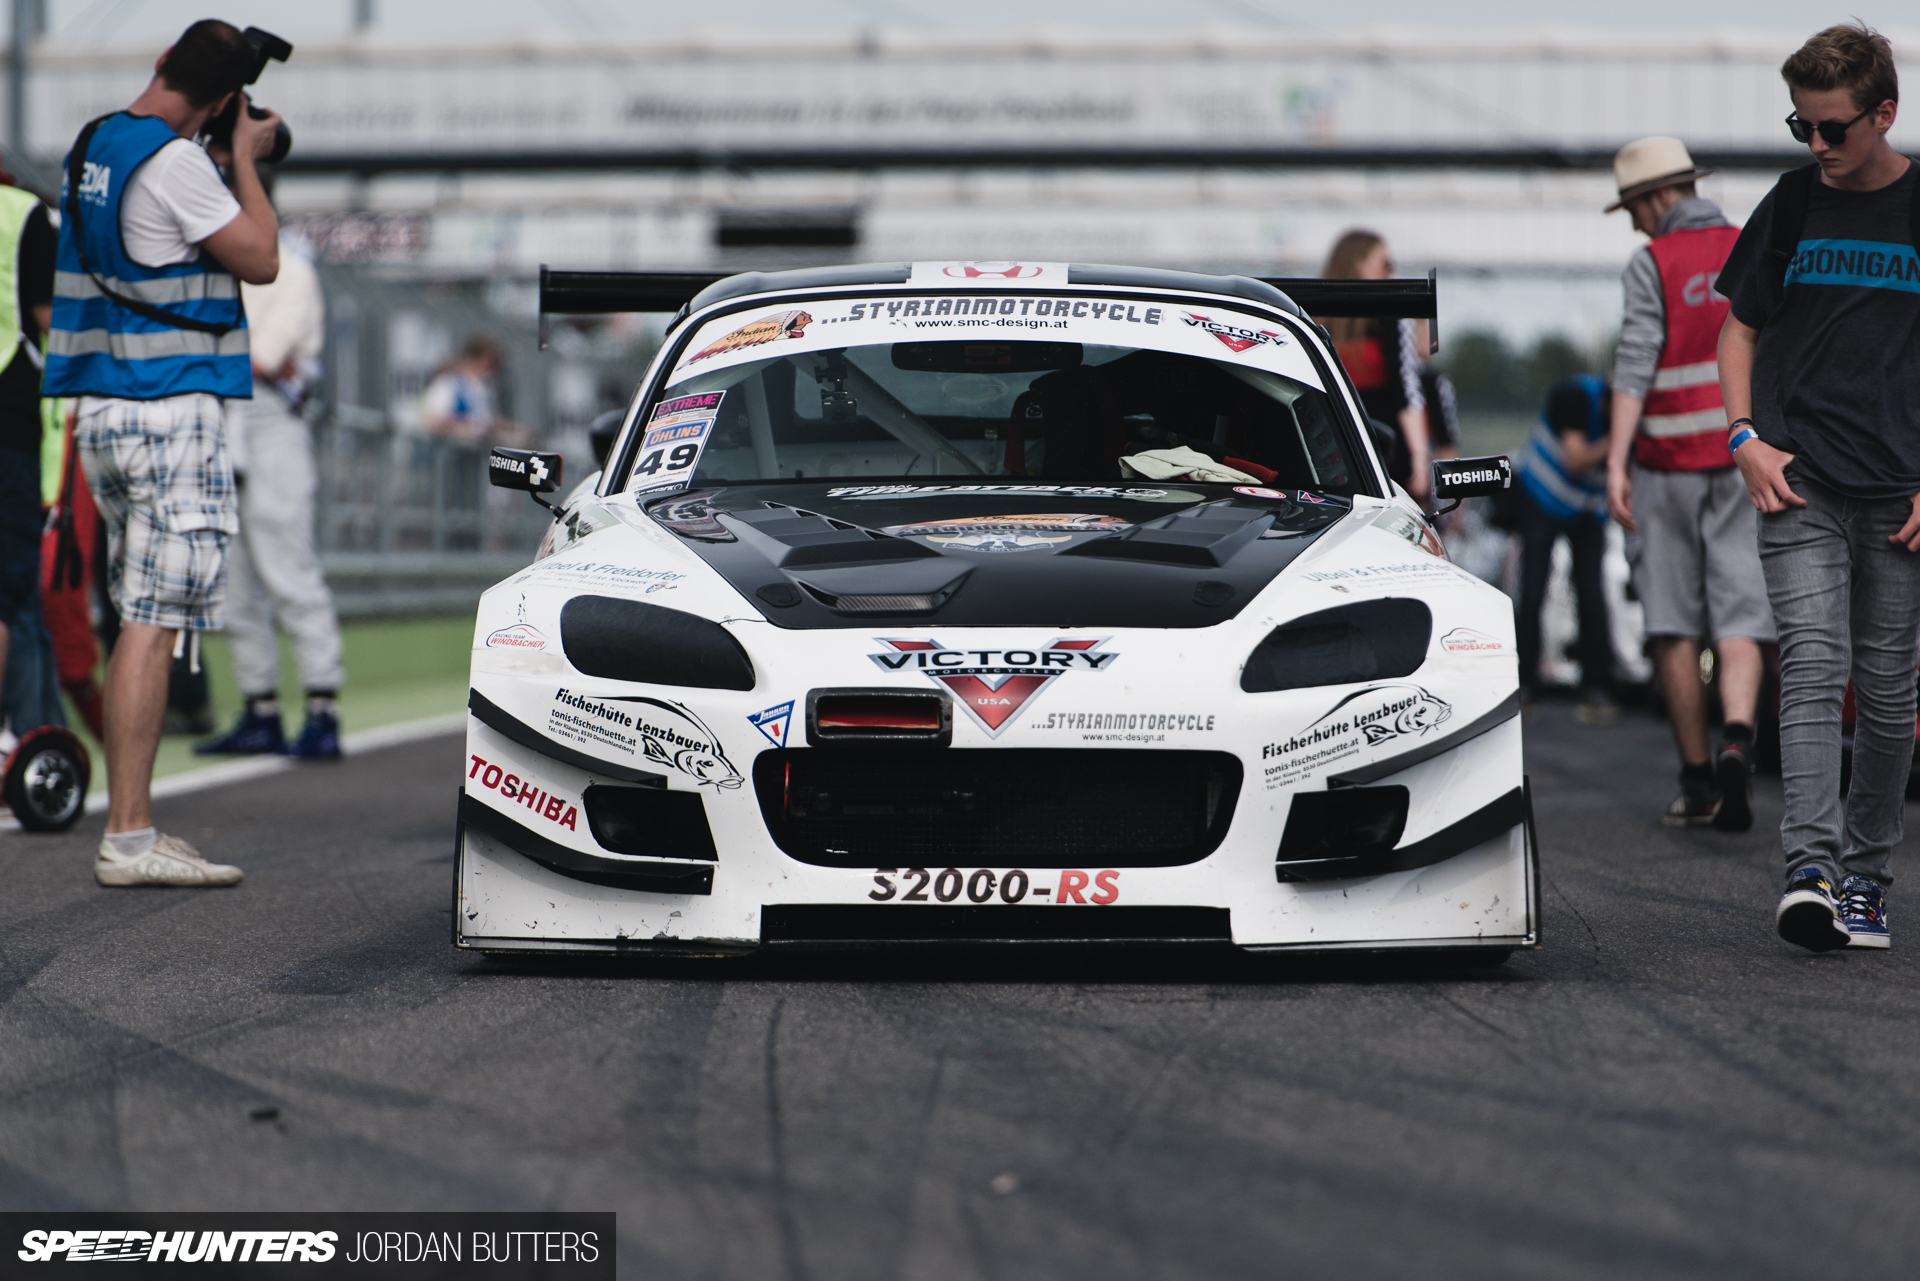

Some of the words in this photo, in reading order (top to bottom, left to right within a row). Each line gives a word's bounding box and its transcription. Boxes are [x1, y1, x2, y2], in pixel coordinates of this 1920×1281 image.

[62, 160, 111, 198] EDIA
[726, 325, 777, 341] Indian
[914, 317, 1069, 329] www.smc-design.at
[1183, 318, 1285, 346] VICTORY
[656, 394, 719, 416] EXTREME
[650, 424, 702, 445] ÖHLINS
[633, 443, 699, 476] 49
[1442, 469, 1501, 486] TOSHIBA
[576, 563, 596, 572] &
[594, 564, 687, 582] Freidorfer
[1301, 569, 1354, 582] Ulbel
[1350, 567, 1370, 576] &
[490, 638, 545, 648] WINDBACHER
[1448, 643, 1503, 651] WINDBACHER
[877, 651, 1111, 669] VICTORY
[977, 697, 1011, 705] USA
[551, 708, 637, 746] tonis-fischerhuette.at
[554, 687, 632, 727] Fischerhütte
[635, 717, 710, 754] Lenzbauer
[1262, 721, 1349, 760] Fischerhütte
[1354, 694, 1418, 728] Lenzbauer
[593, 733, 635, 755] Deutschlandsberg
[1082, 733, 1165, 743] www.smc-design.at
[1264, 737, 1359, 776] tonis-fischerhuette.at
[469, 754, 578, 832] TOSHIBA
[868, 868, 1121, 904] S2000-RS
